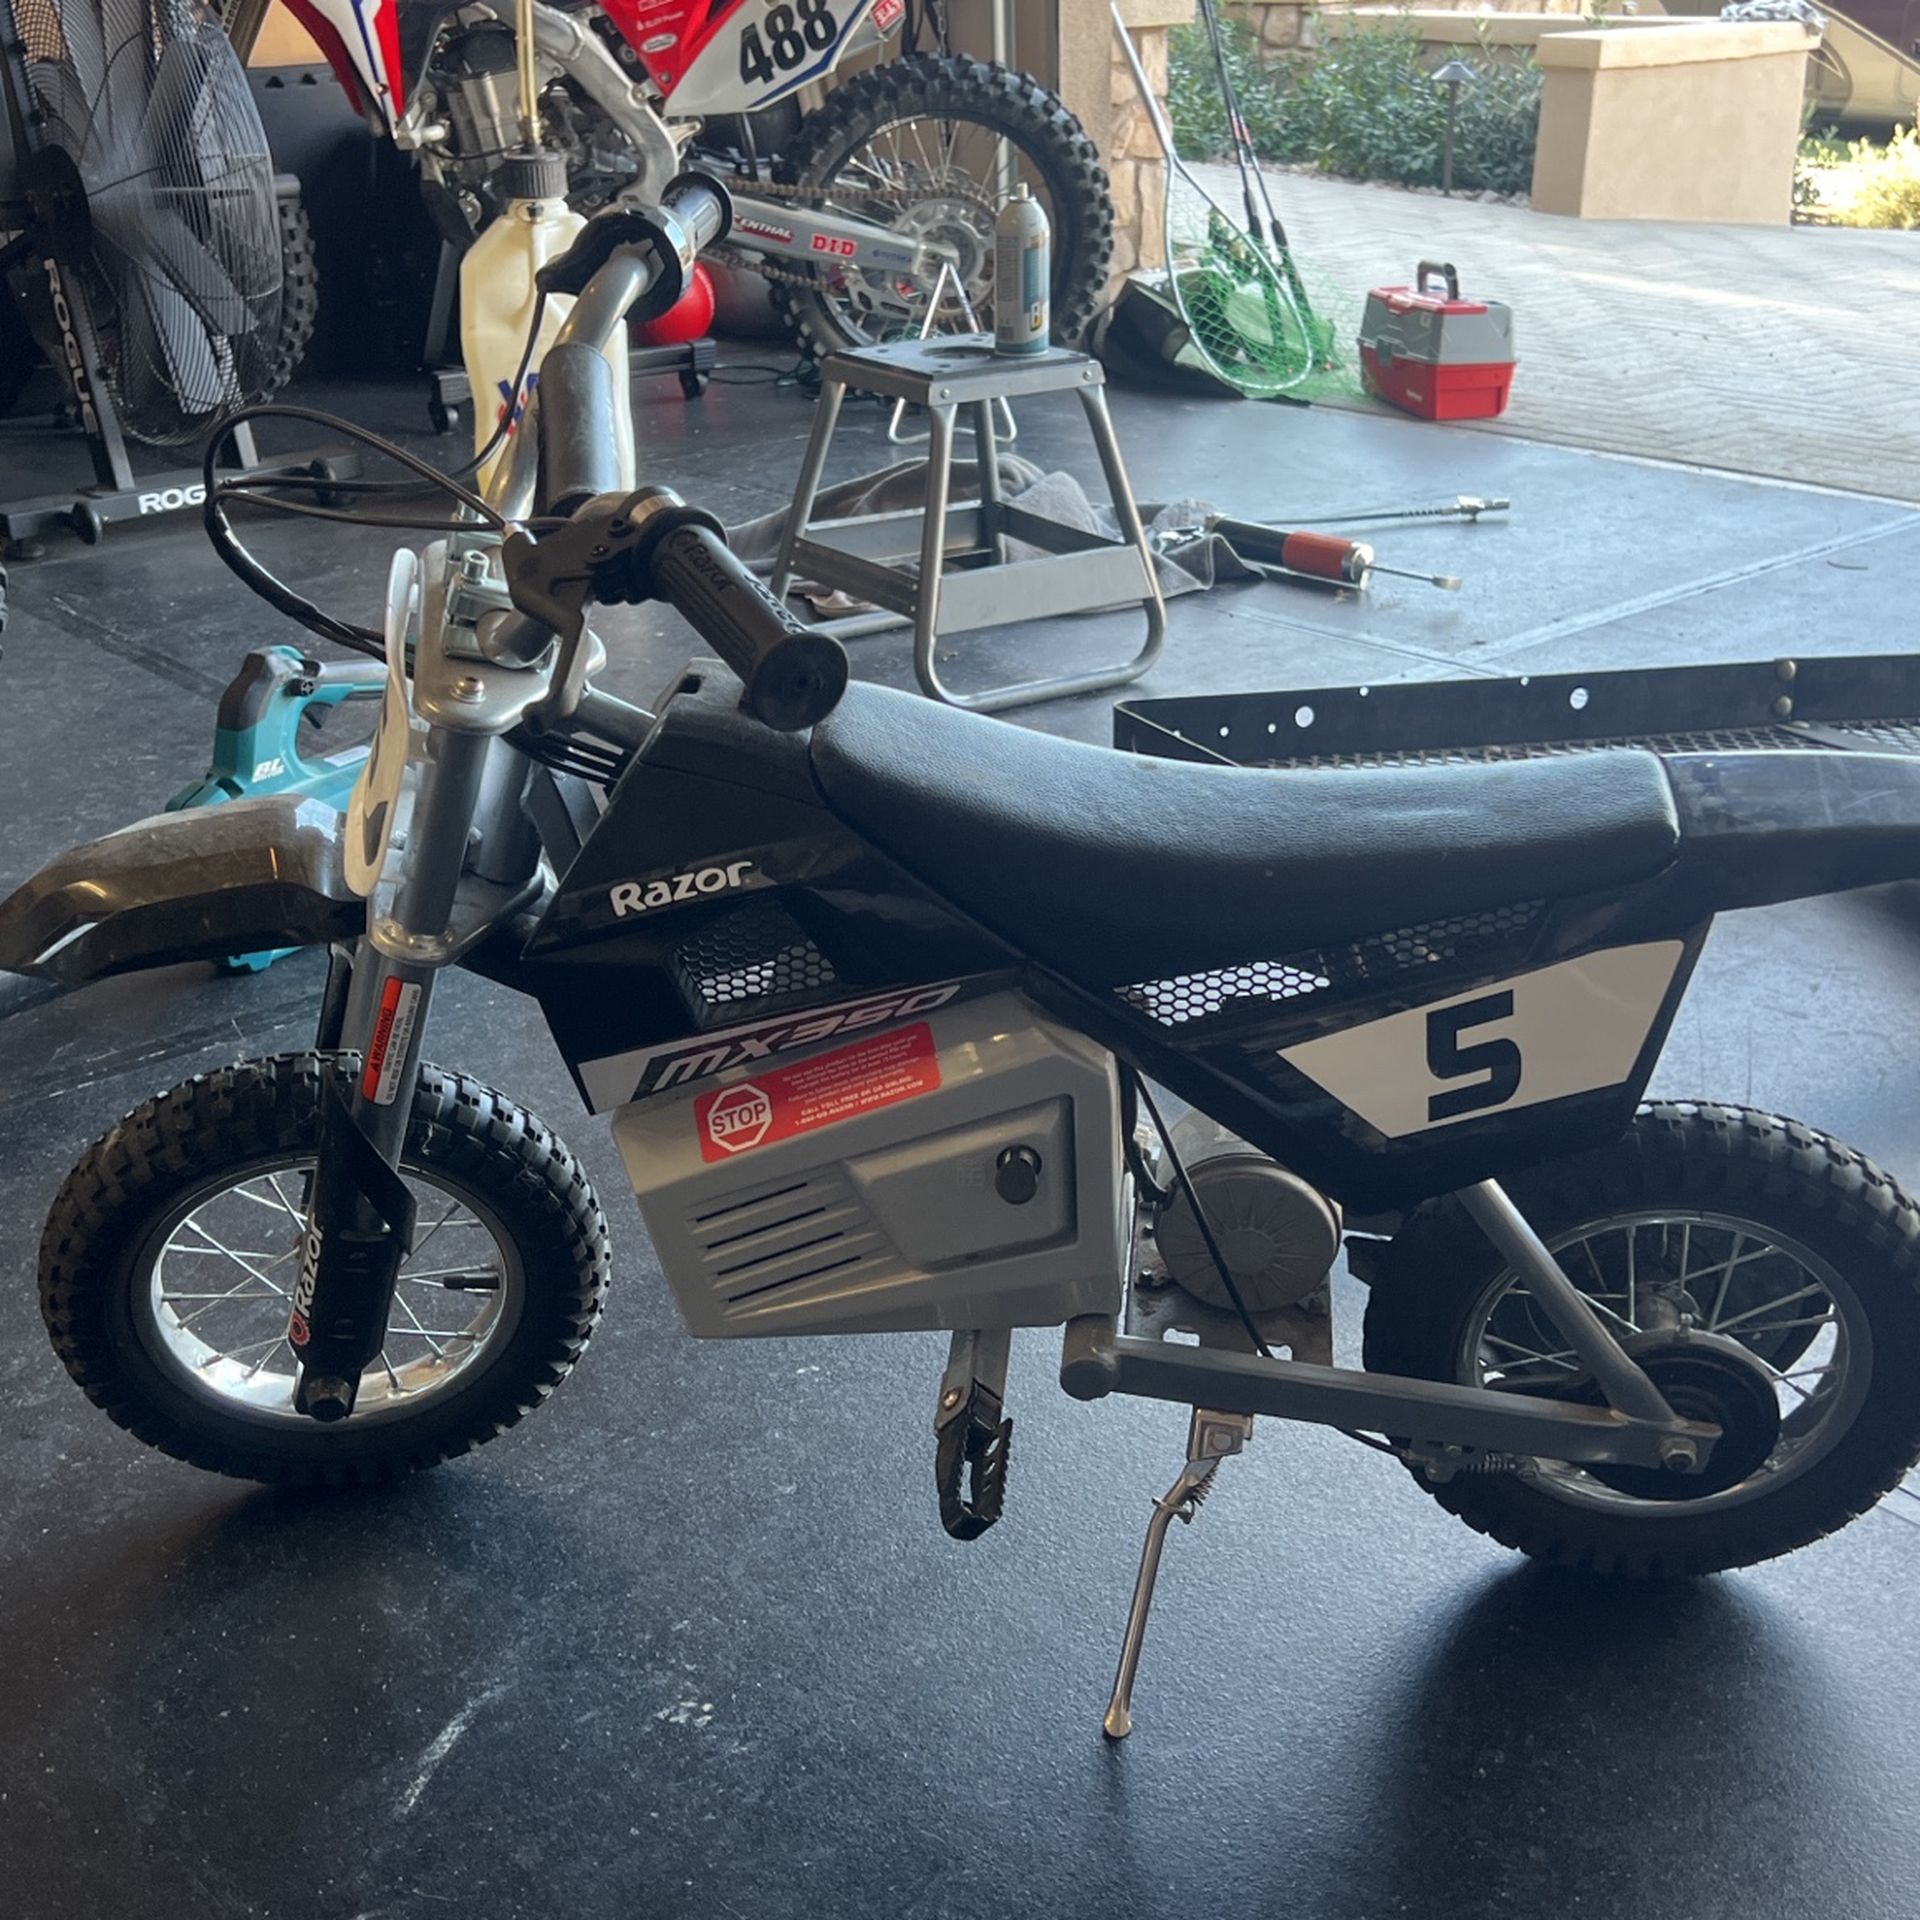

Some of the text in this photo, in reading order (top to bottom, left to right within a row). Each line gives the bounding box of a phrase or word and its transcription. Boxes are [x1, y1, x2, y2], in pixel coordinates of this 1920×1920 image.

[740, 0, 837, 85] 488
[43, 257, 99, 434] ROGUE
[138, 483, 207, 514] ROG
[609, 861, 753, 917] Razor
[648, 984, 962, 1093] MX350
[1426, 989, 1522, 1123] 5
[711, 1102, 767, 1135] STOP
[294, 1212, 324, 1318] Razor
